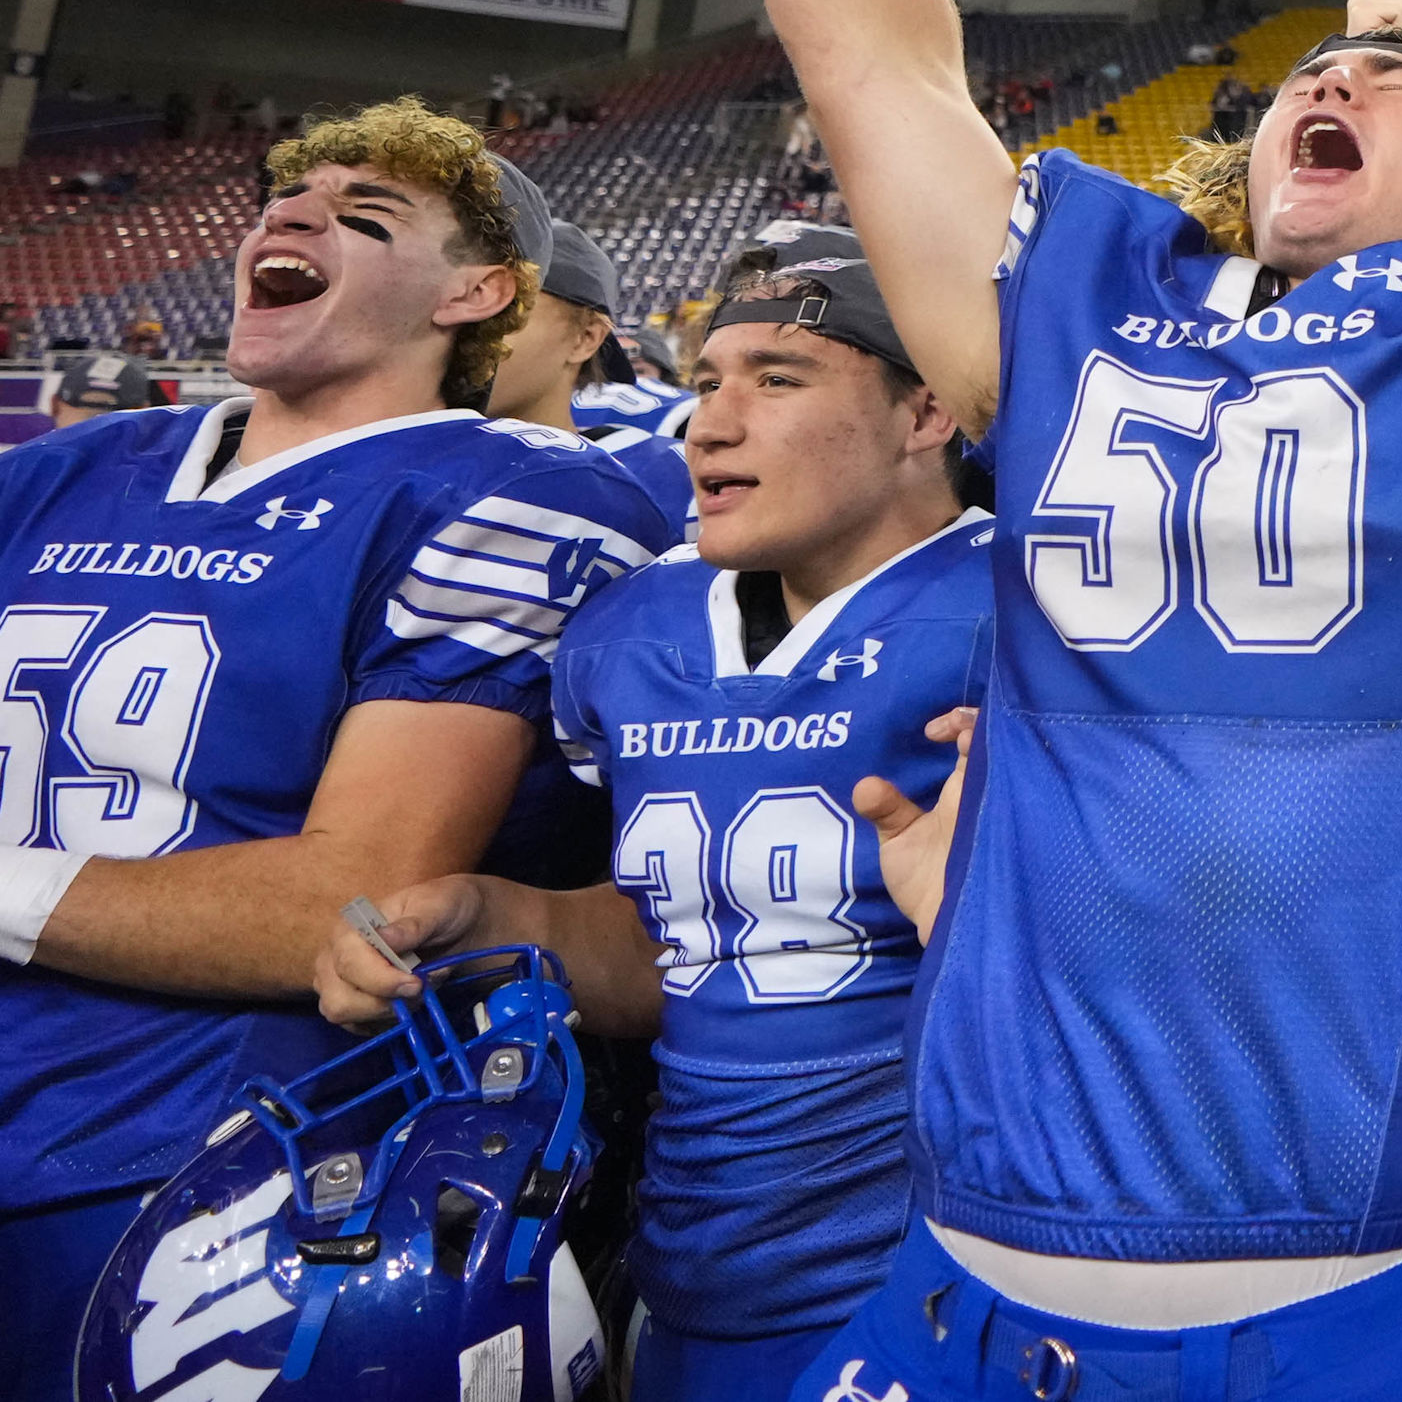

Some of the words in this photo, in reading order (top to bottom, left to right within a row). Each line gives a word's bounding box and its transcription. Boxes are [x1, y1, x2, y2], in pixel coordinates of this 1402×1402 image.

[28, 542, 273, 585] BULLDOGS
[1024, 349, 1367, 654] 50
[0, 604, 221, 859] 59
[618, 709, 852, 759] BULLDOGS
[614, 785, 873, 1003] 38
